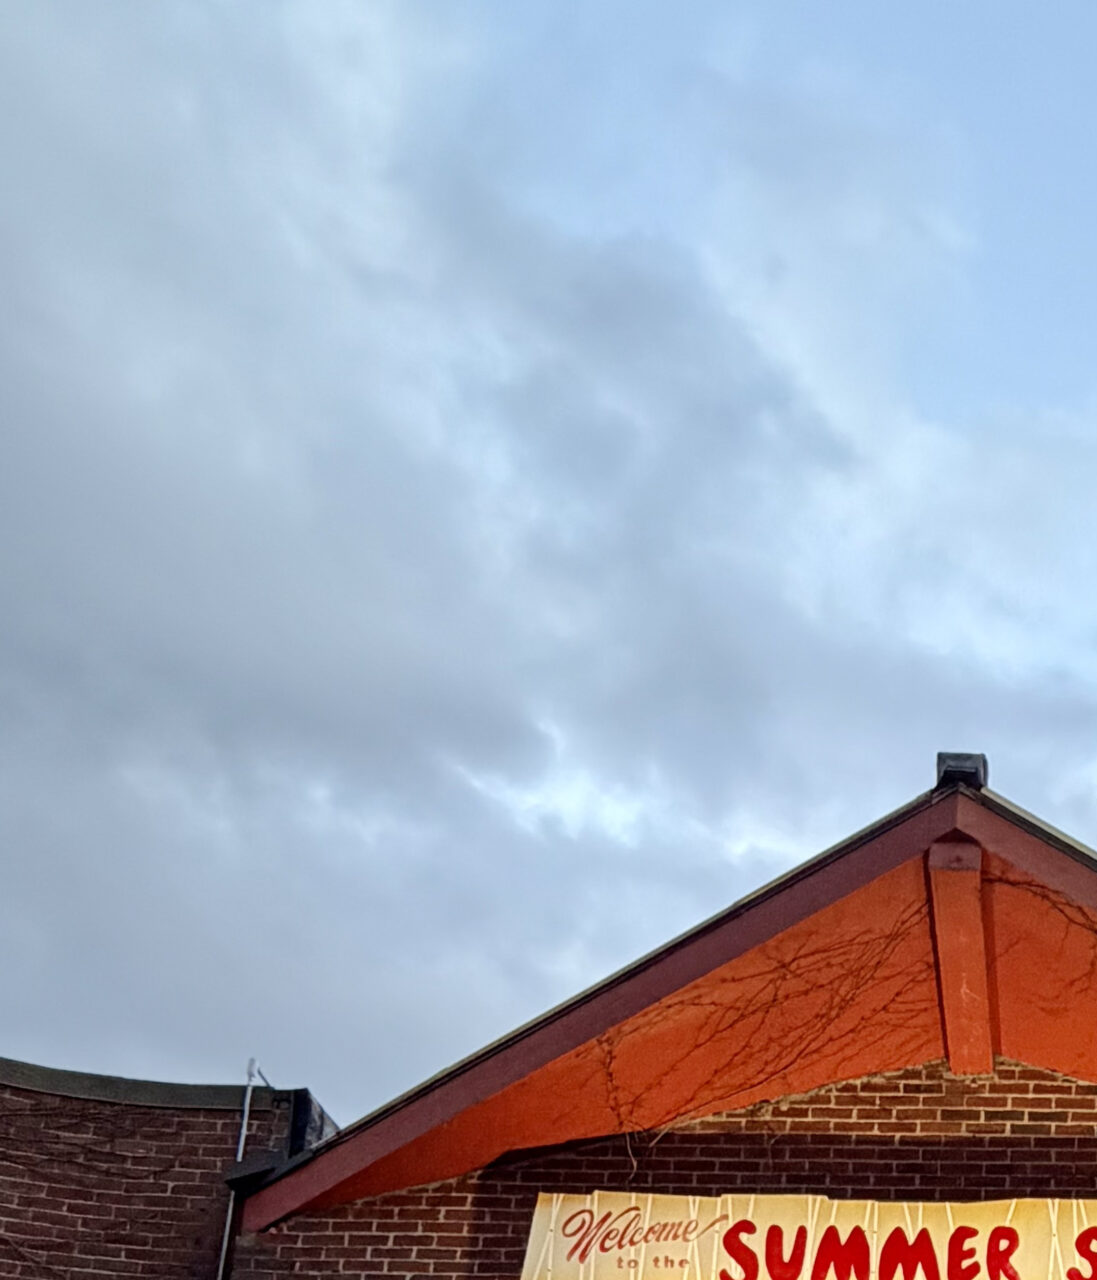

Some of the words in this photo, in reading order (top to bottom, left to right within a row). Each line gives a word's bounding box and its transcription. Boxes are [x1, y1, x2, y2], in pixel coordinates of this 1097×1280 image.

[561, 1205, 729, 1264] Welcome
[616, 1255, 640, 1269] to
[652, 1254, 690, 1269] the
